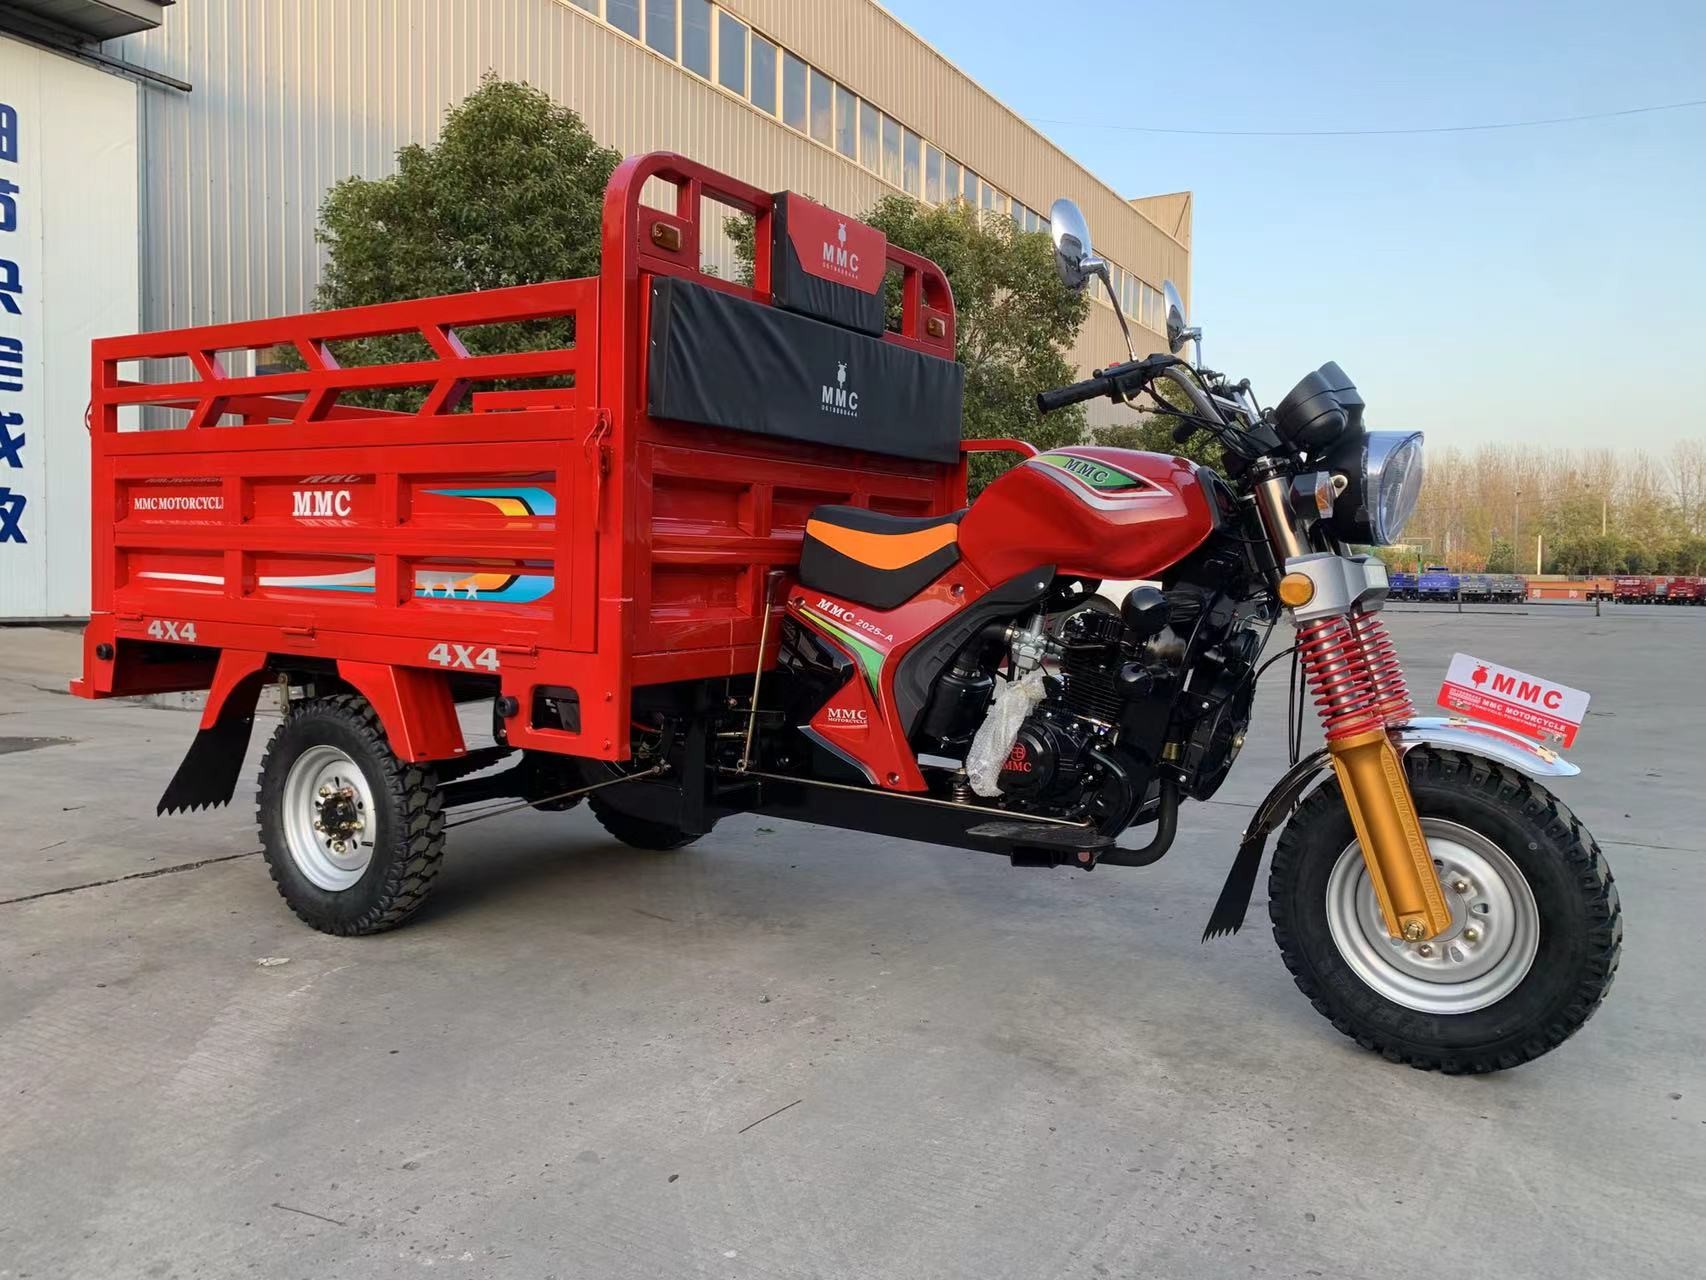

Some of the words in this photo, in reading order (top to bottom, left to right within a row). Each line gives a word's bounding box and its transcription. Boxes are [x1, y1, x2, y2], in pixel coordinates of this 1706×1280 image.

[822, 242, 859, 272] MMC
[822, 385, 859, 410] MMC
[1063, 458, 1109, 483] MMC
[134, 497, 157, 510] MMC
[292, 490, 351, 517] MMC
[147, 619, 197, 642] 4X4
[816, 598, 855, 622] MMC
[855, 619, 894, 642] 2025-A
[428, 643, 500, 671] 4X4
[1491, 672, 1563, 710] MMC
[827, 707, 867, 720] MMC
[1482, 698, 1503, 711] MMC
[1505, 706, 1567, 732] MOTORCYCLE
